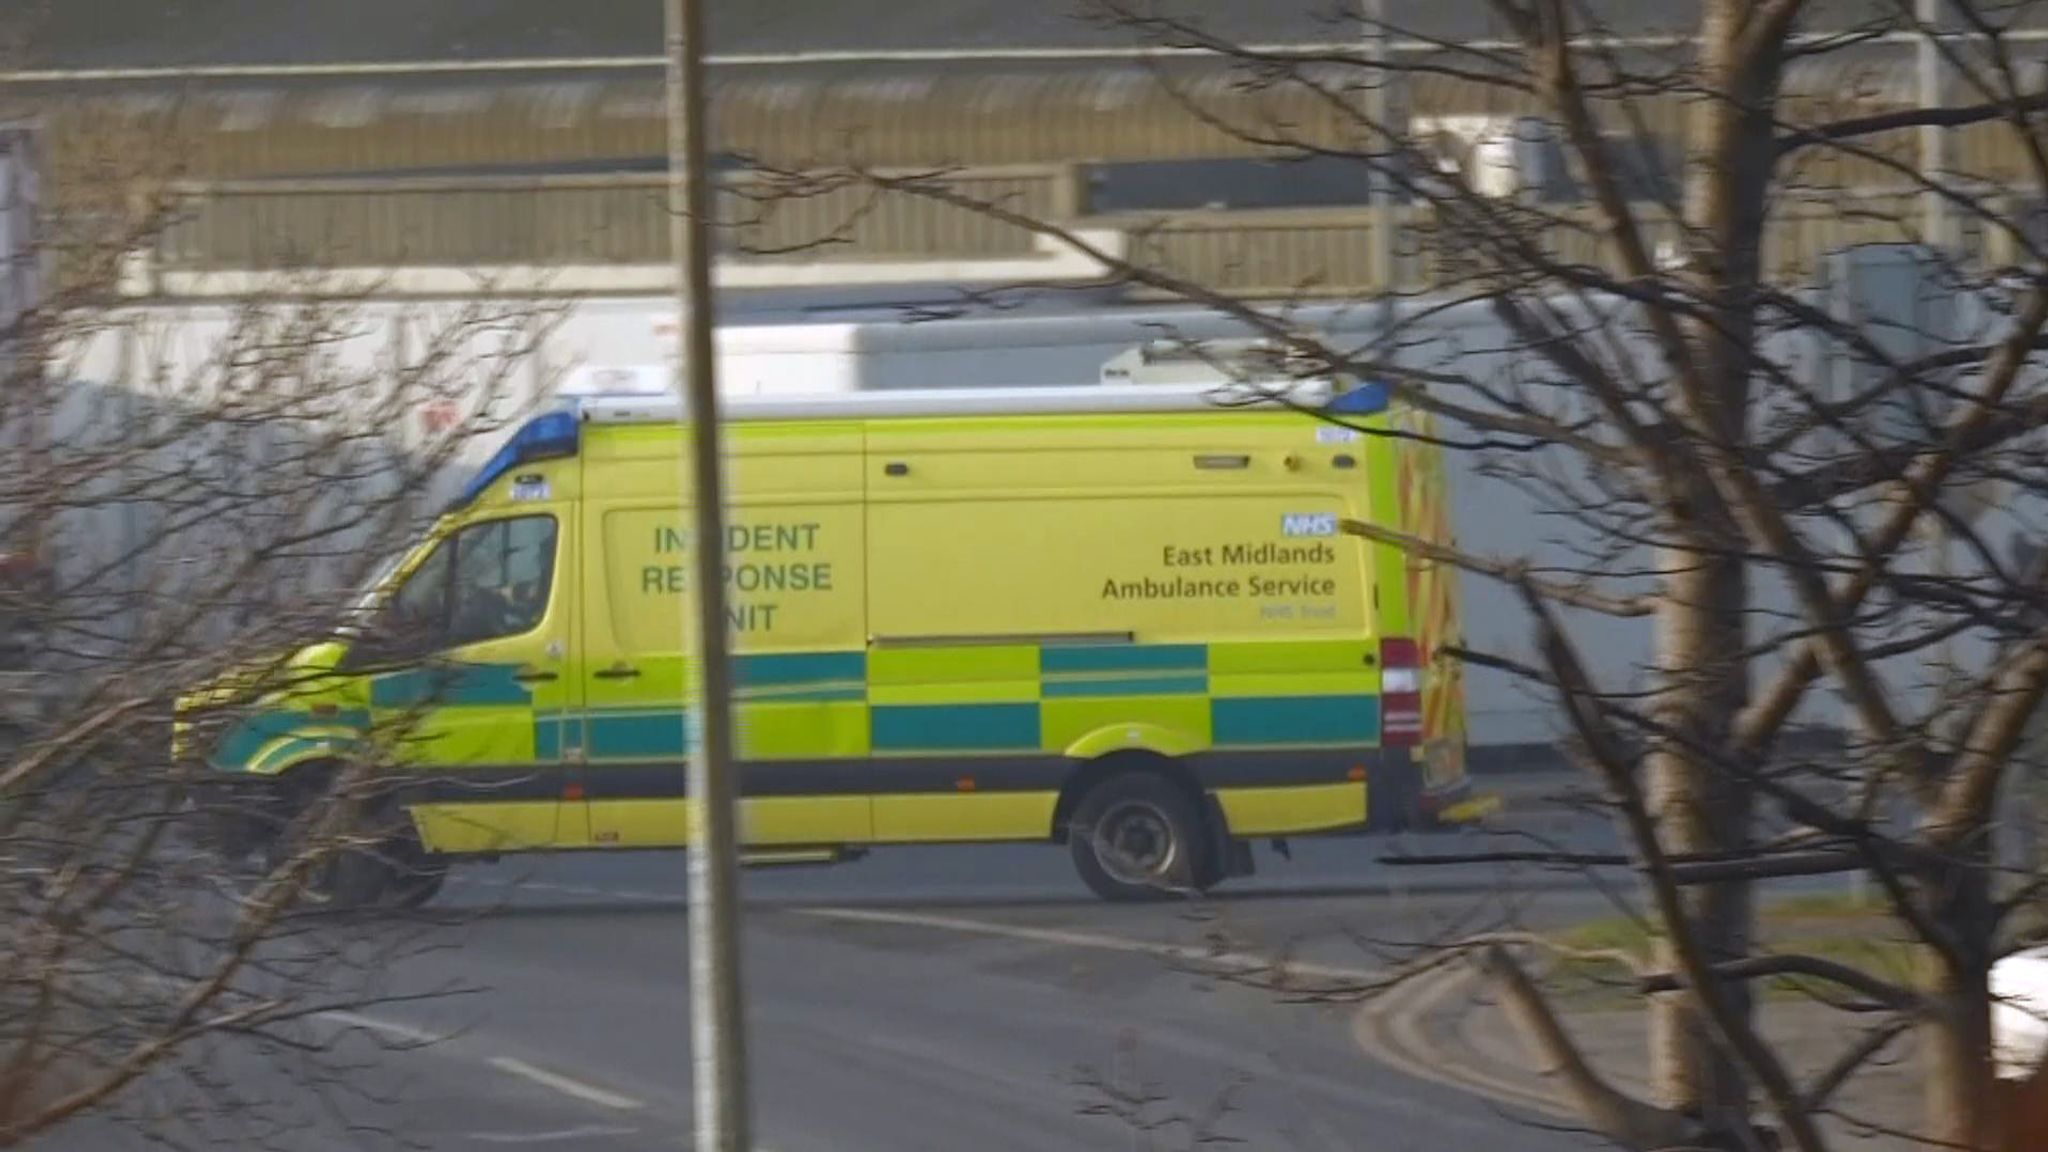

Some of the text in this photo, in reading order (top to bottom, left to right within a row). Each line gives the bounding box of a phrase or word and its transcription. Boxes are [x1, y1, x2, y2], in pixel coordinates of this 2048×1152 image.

[655, 523, 820, 552] INDENT
[1283, 514, 1335, 536] NHS
[1163, 542, 1335, 567] East Midlands
[642, 563, 832, 594] REPONSE
[1101, 573, 1335, 600] Ambulance Service
[722, 603, 778, 632] NIT
